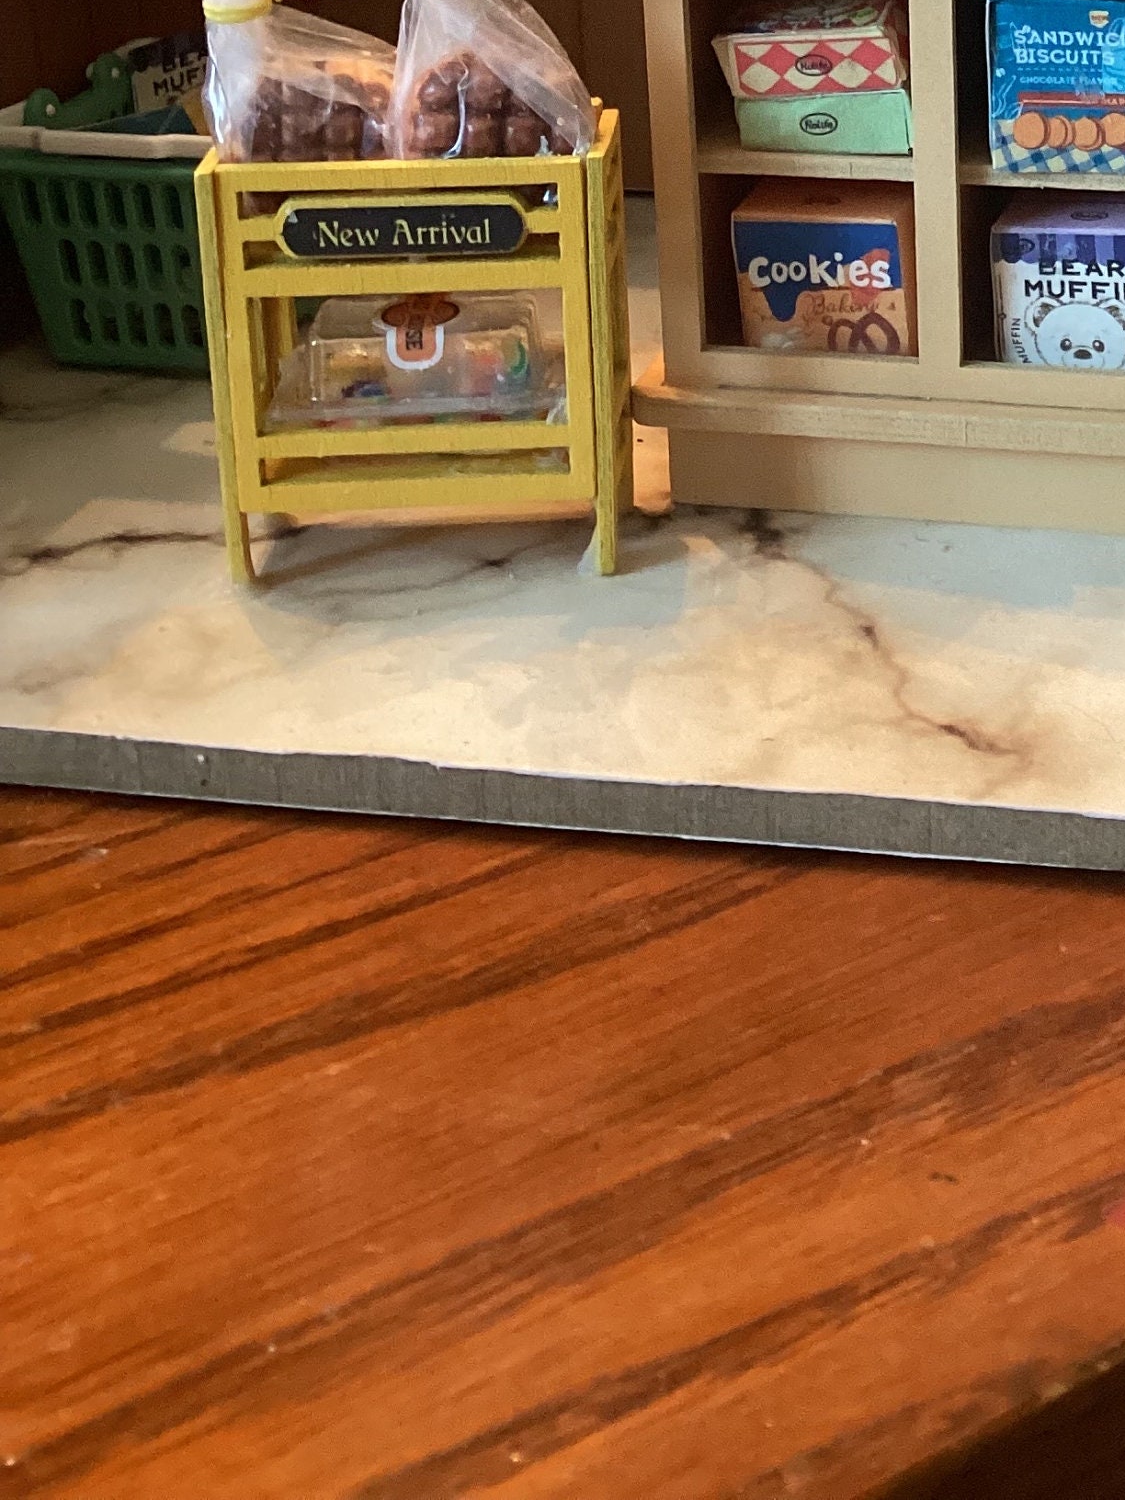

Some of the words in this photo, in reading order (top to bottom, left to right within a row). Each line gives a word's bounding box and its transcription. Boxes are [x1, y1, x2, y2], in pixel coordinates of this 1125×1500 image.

[1015, 49, 1115, 67] BISCUITS
[317, 221, 380, 248] New
[392, 218, 491, 246] Arrival
[749, 252, 891, 289] Cookies
[1038, 259, 1125, 277] BEAR
[1011, 318, 1032, 364] MUFFIN
